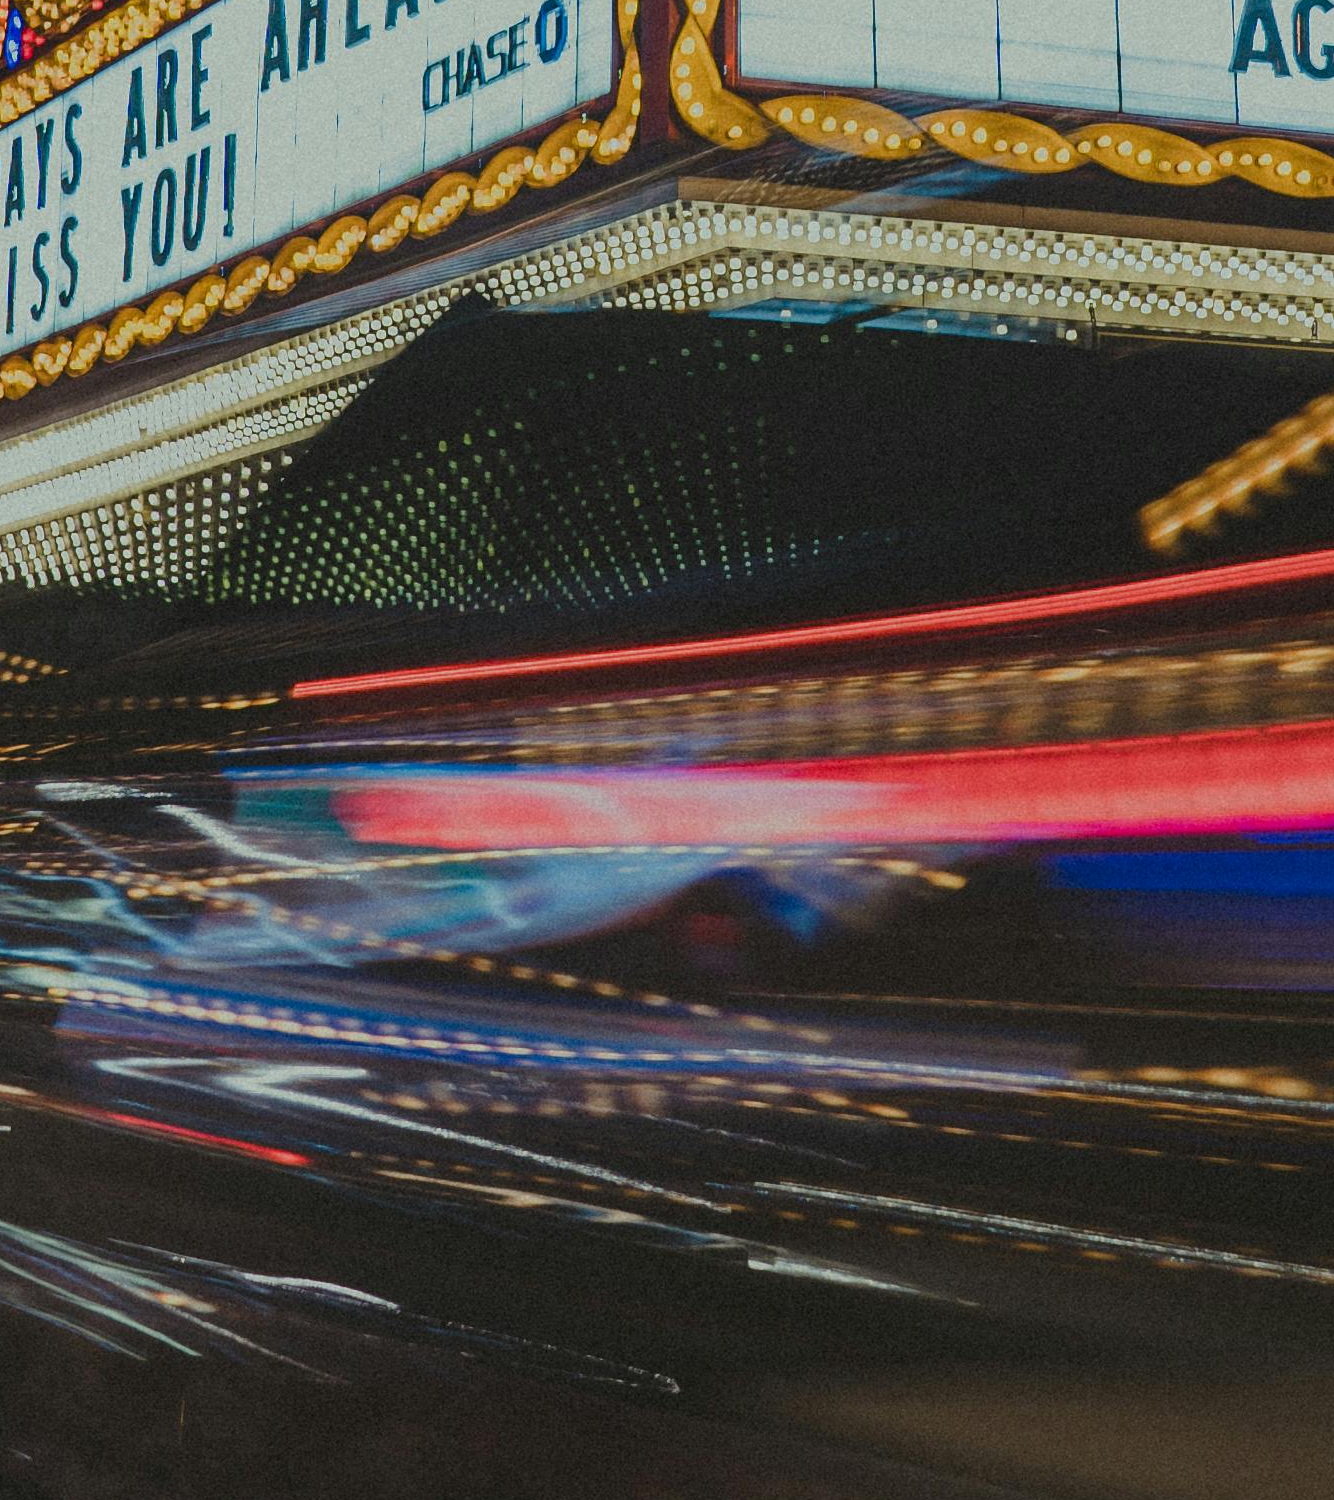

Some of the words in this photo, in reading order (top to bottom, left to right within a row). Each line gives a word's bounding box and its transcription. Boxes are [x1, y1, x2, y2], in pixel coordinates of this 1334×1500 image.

[122, 22, 213, 167] ARE
[422, 16, 530, 114] CHASE
[121, 132, 237, 282] YOU!
